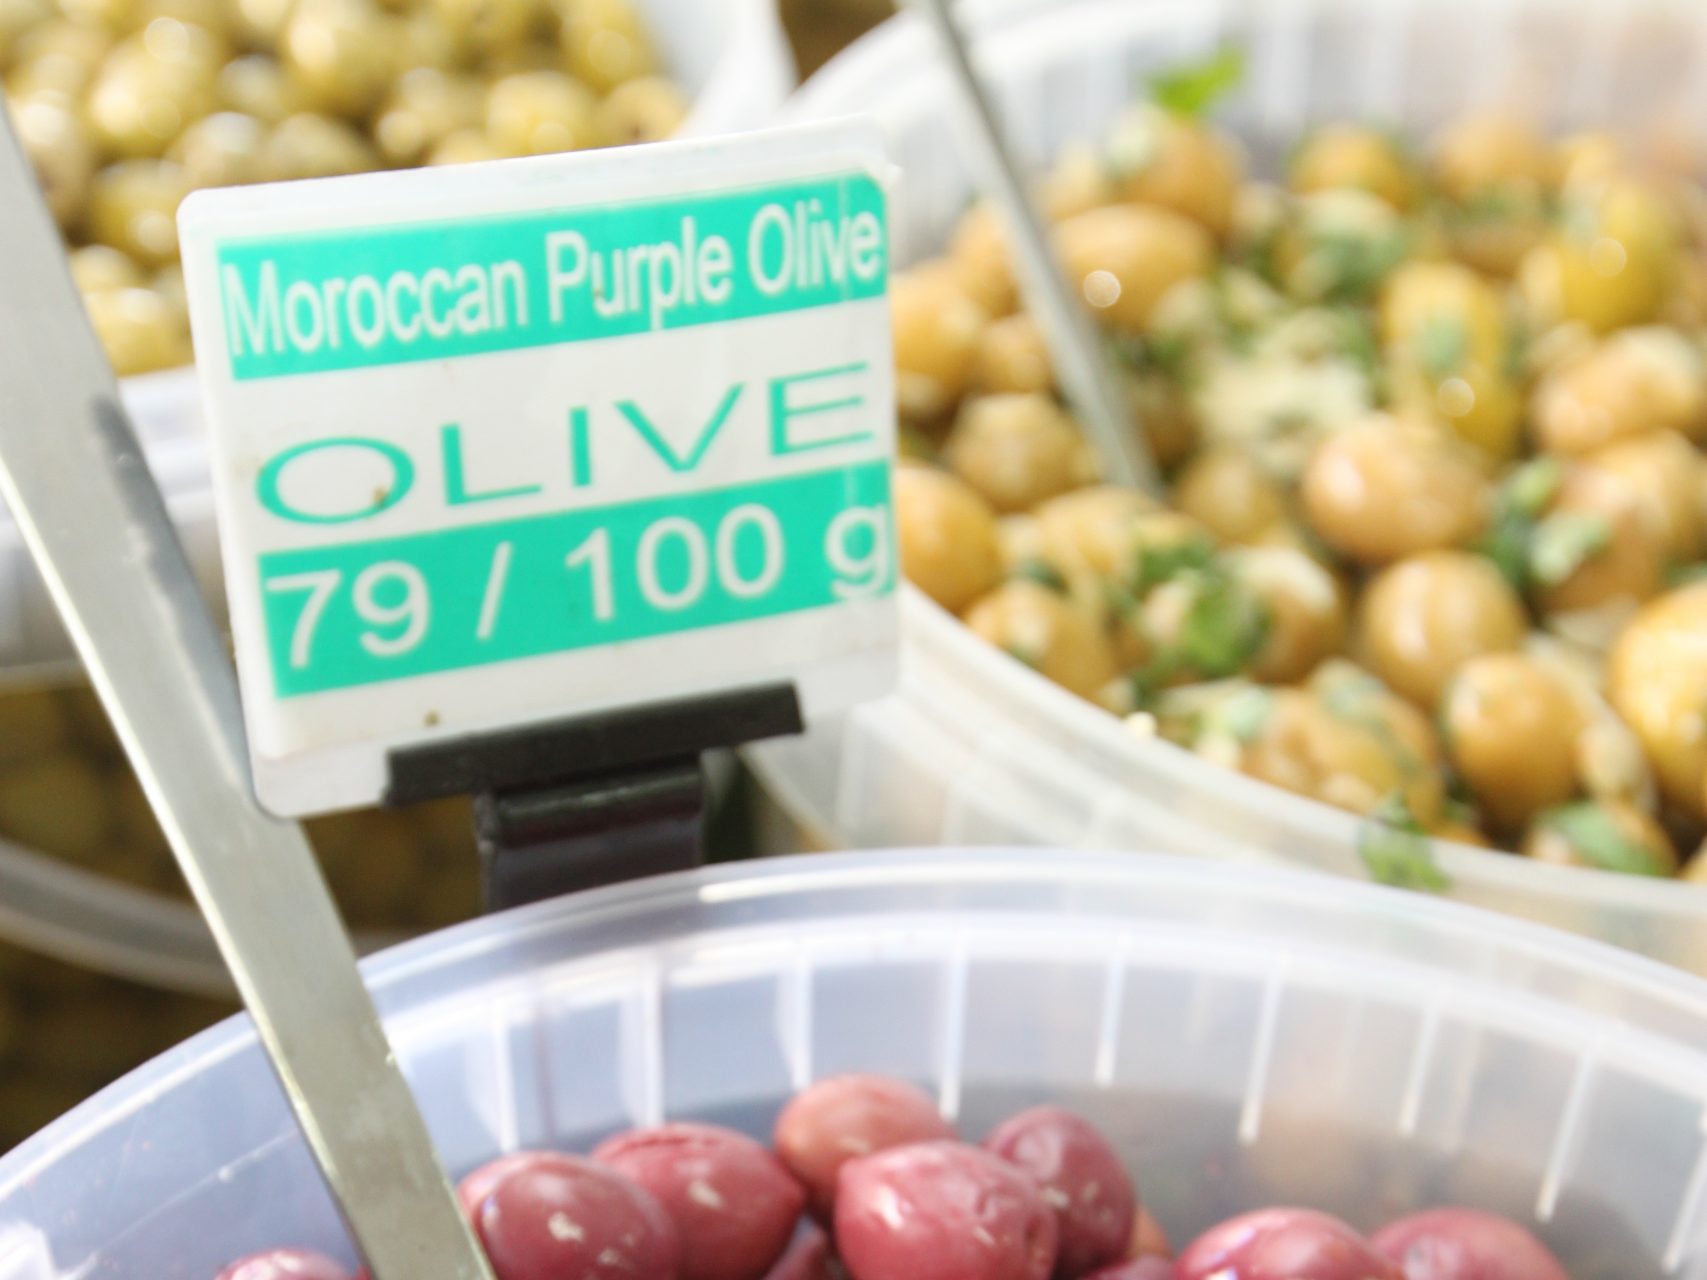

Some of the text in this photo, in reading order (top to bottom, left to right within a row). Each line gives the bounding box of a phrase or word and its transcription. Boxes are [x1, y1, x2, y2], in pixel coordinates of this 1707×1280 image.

[221, 197, 881, 356] Moroccan Purple Olive
[255, 362, 874, 525] OLIVE
[264, 502, 890, 669] 79 / 100 g
